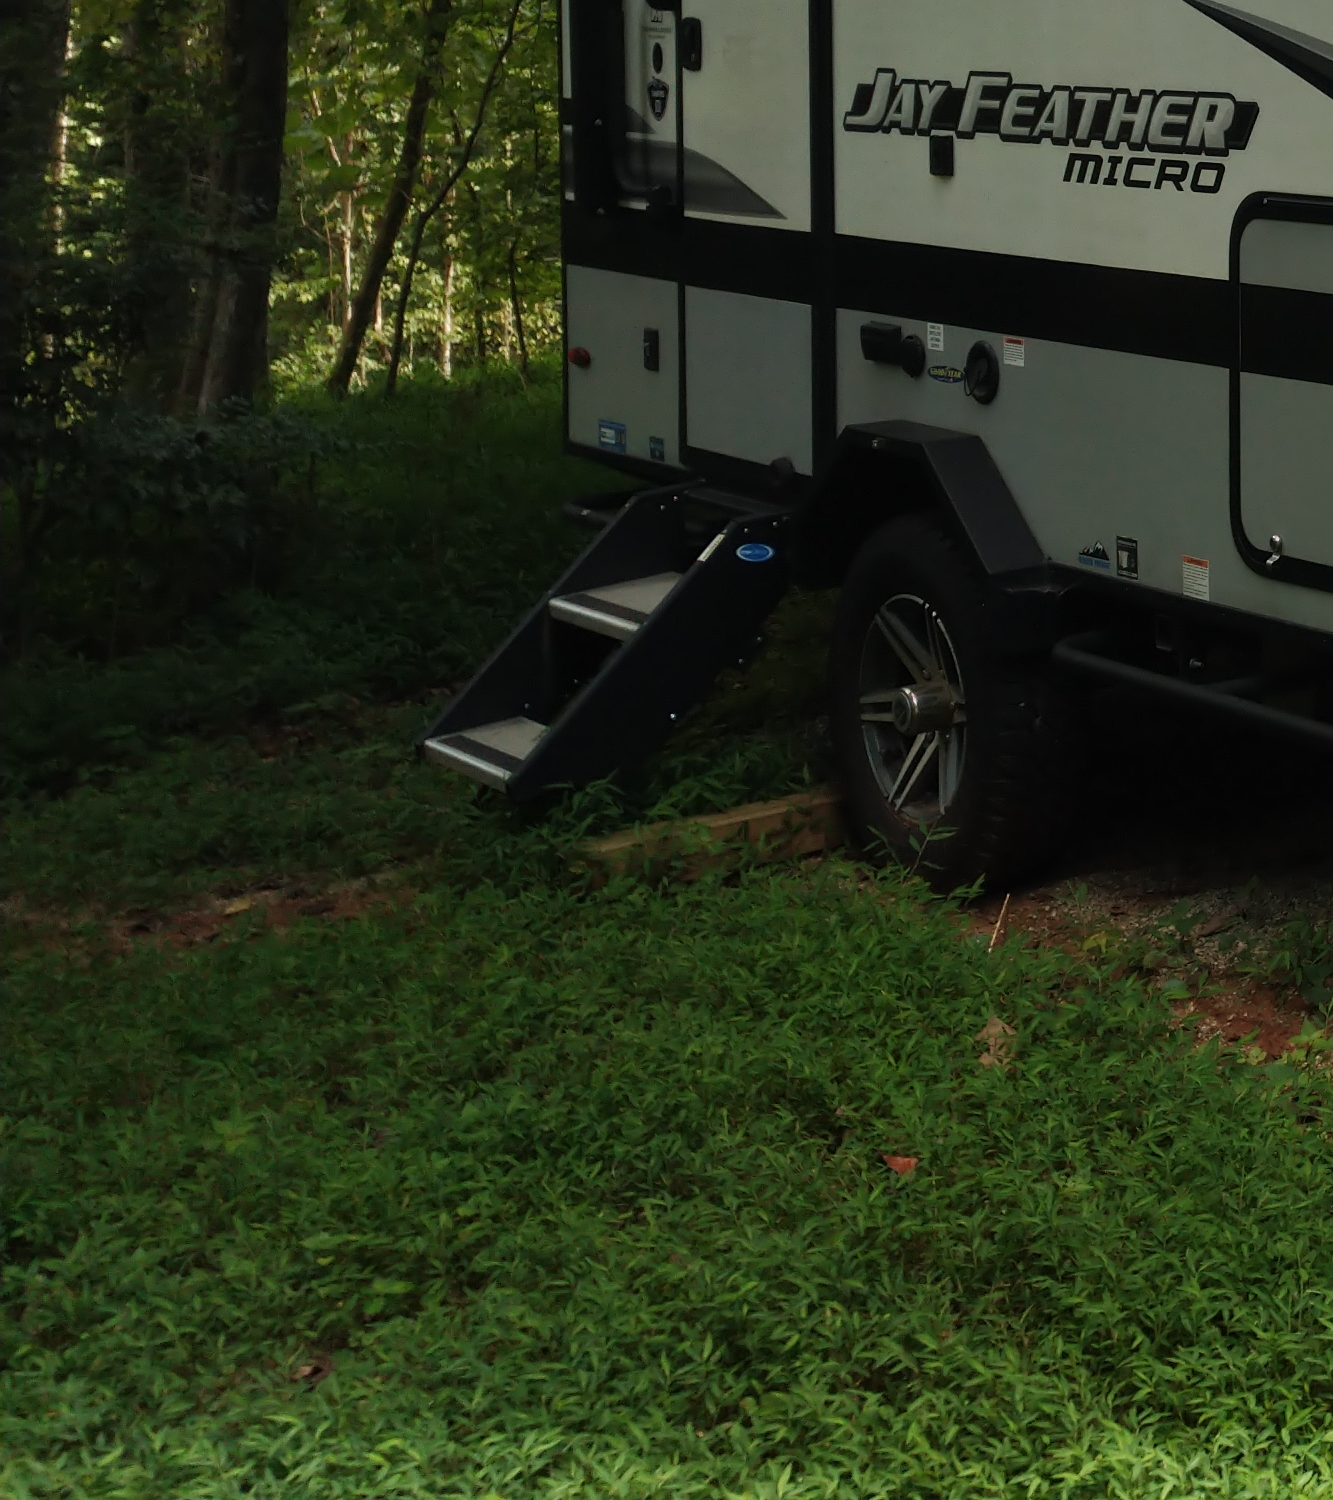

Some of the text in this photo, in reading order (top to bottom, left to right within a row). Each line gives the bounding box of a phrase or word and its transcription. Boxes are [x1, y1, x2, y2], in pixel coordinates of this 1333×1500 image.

[845, 68, 1236, 155] JAY FEATHER
[1063, 152, 1226, 194] MICRO
